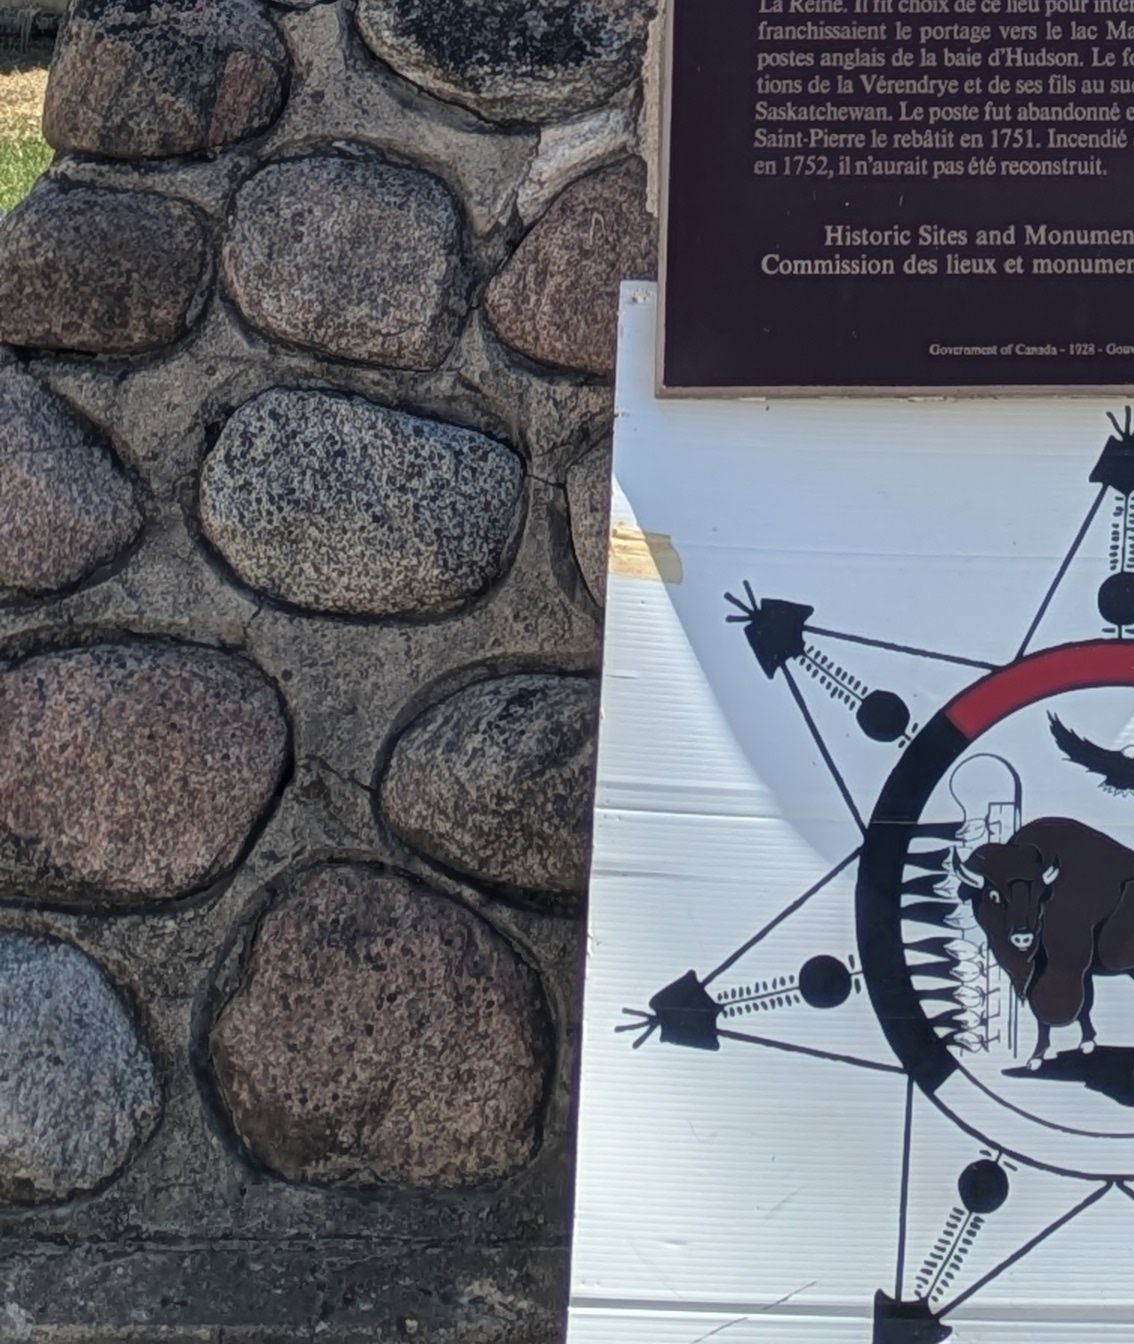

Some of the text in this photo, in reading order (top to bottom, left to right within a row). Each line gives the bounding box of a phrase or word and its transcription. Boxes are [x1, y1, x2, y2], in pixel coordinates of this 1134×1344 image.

[757, 20, 887, 41] franchissaient
[895, 20, 913, 41] le
[919, 23, 992, 45] portage
[998, 25, 1038, 41] vers
[1045, 20, 1063, 41] le
[1069, 20, 1099, 41] lac
[754, 100, 894, 122] Saskatchewan.
[898, 100, 925, 122] Le
[928, 103, 980, 125] poste
[983, 100, 1013, 122] fut
[1016, 101, 1122, 122] abandonné
[753, 127, 866, 149] Saint-Pierre
[870, 127, 889, 149] le
[892, 127, 955, 149] rebâtit
[959, 132, 985, 149] en
[990, 127, 1042, 149] 1751.
[1047, 127, 1129, 149] Incendié
[823, 224, 912, 247] Historic
[918, 223, 968, 246] Sites
[975, 224, 1017, 246] and
[760, 253, 896, 276] Commission
[902, 253, 939, 275] des
[945, 252, 998, 275] lieux
[1002, 255, 1025, 275] et
[928, 343, 998, 356] Government
[1000, 343, 1014, 356] of
[1015, 343, 1058, 356] Canada
